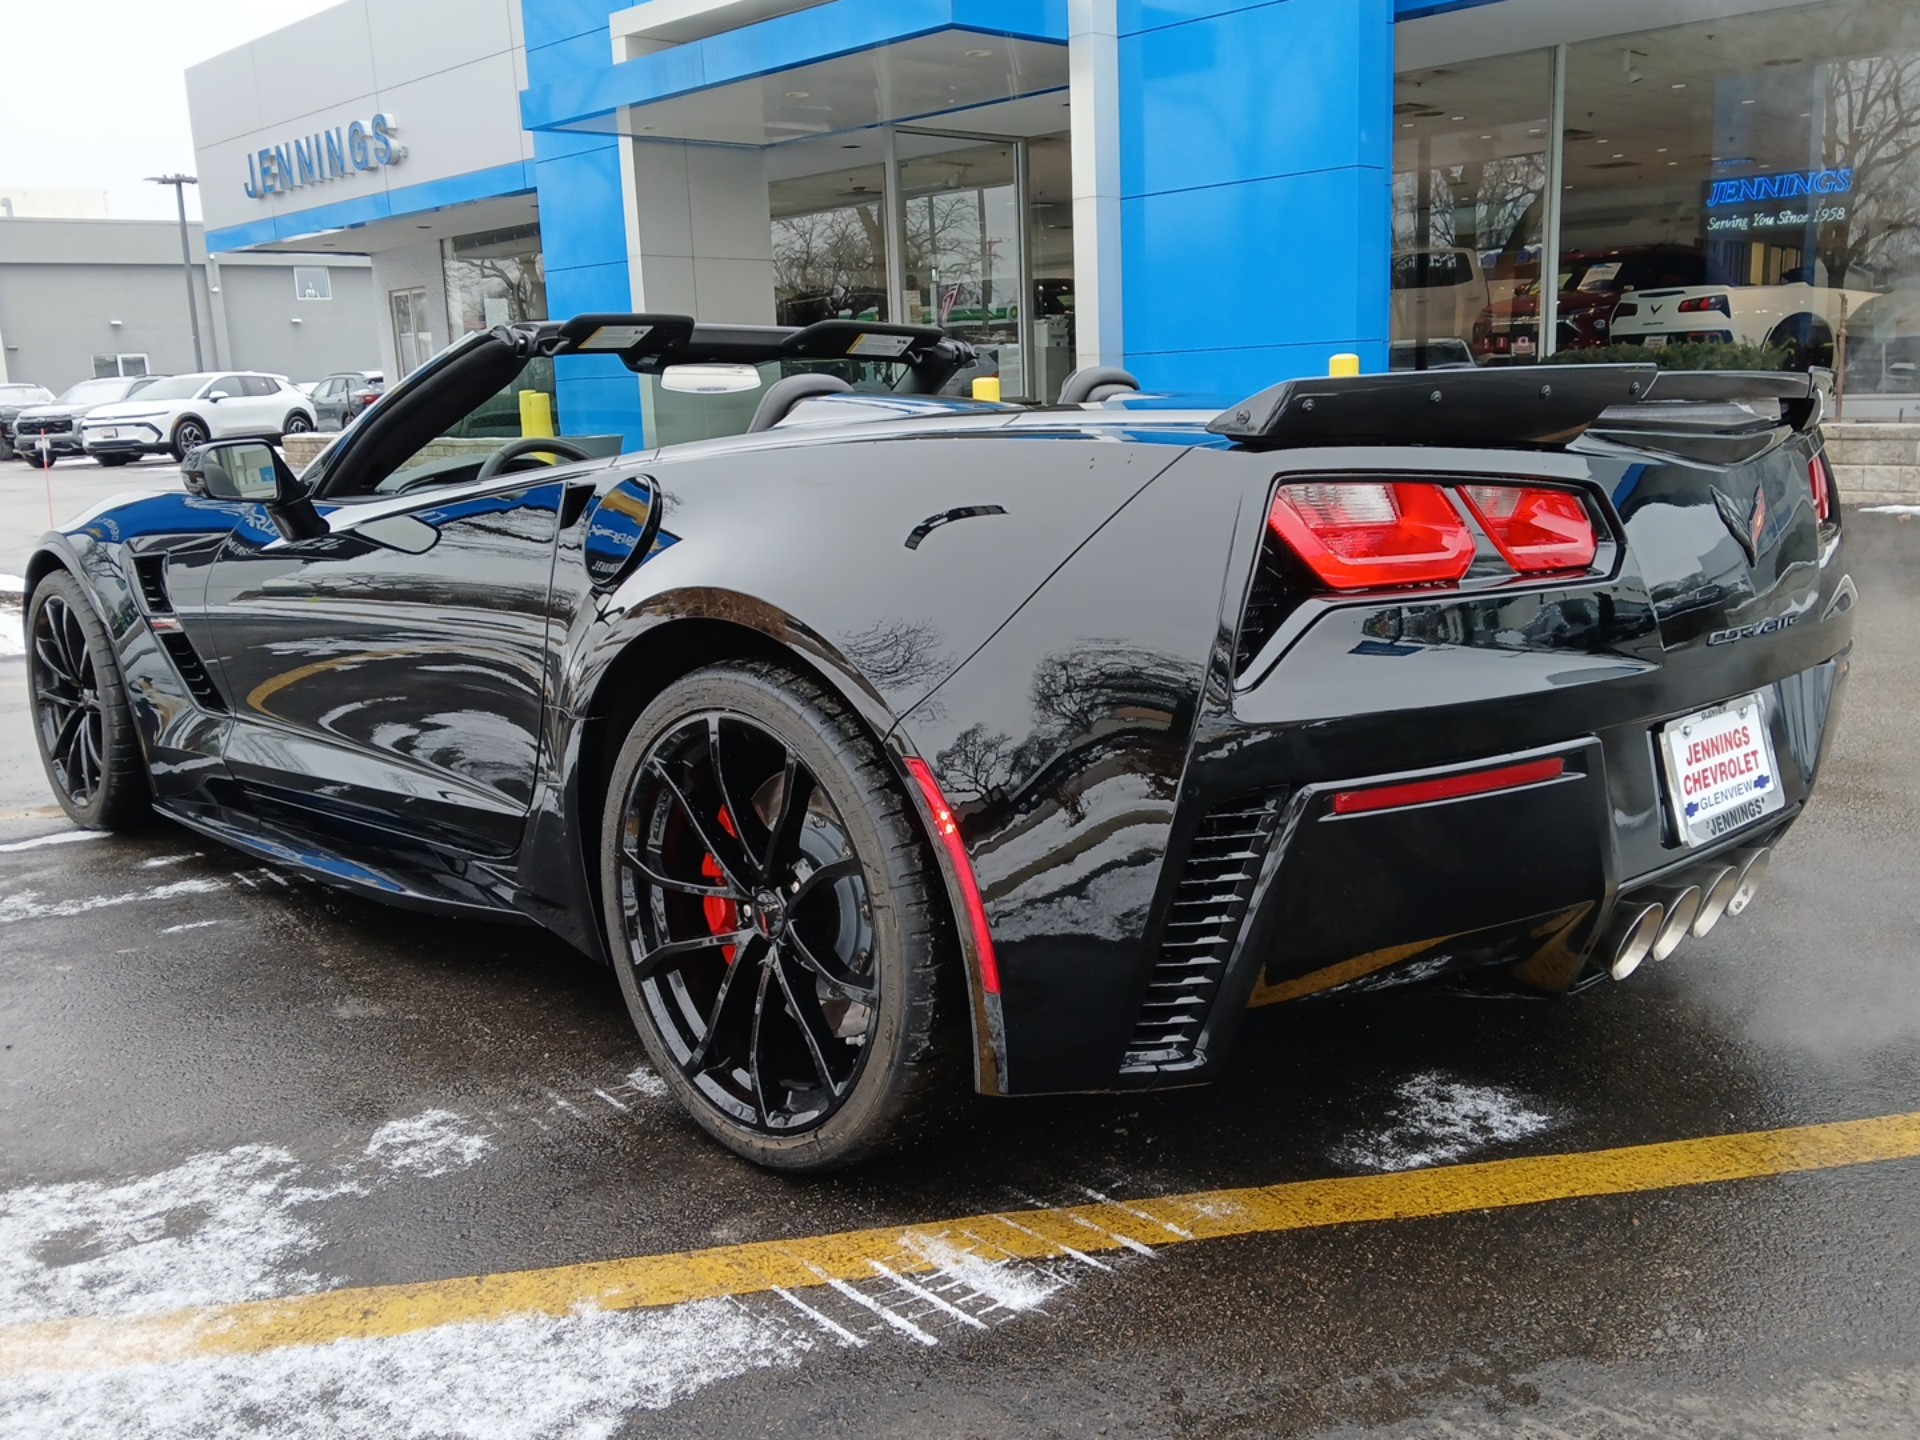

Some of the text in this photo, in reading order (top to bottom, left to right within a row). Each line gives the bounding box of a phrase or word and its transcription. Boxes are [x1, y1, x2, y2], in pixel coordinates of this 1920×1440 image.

[243, 113, 397, 199] JENNINGS
[1706, 168, 1853, 208] JENNINGS
[1707, 207, 1846, 231] Serving You Since 1958
[1685, 725, 1751, 767] JENNINGS
[1683, 749, 1759, 796] CHEVROLET
[1700, 780, 1754, 810] GLENVIEW
